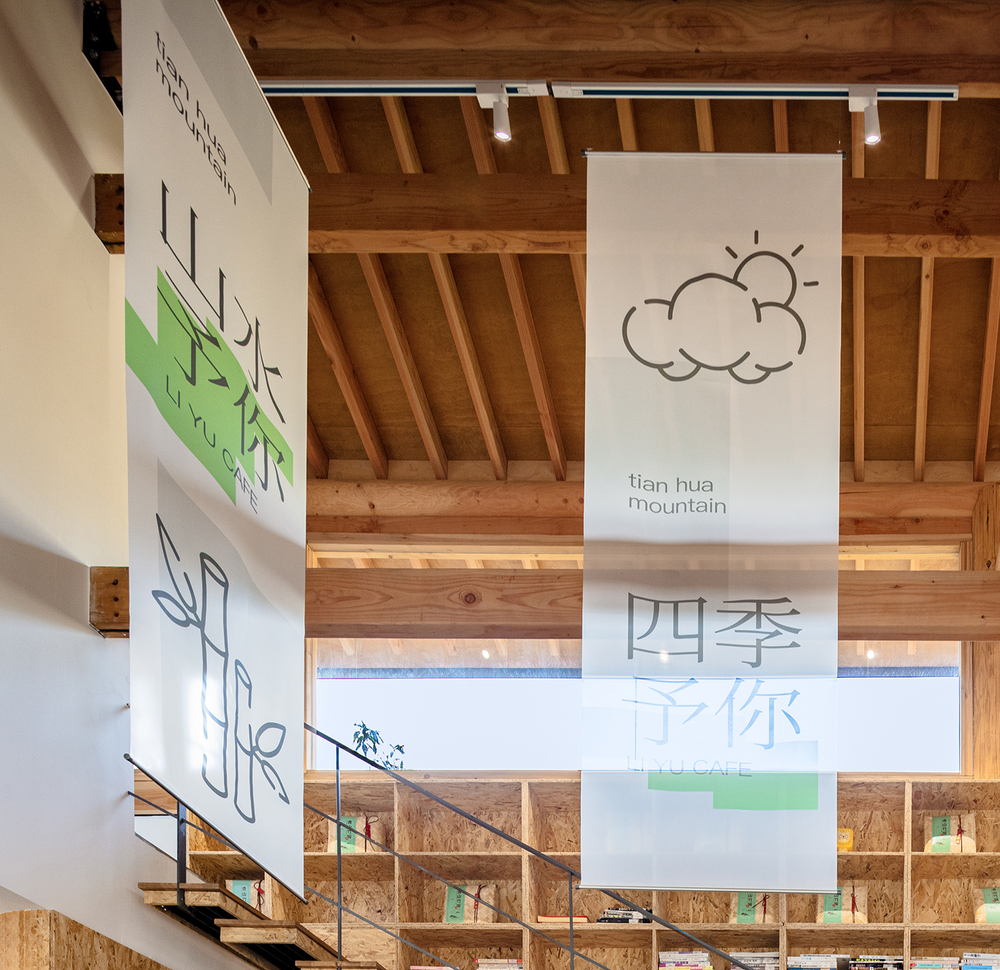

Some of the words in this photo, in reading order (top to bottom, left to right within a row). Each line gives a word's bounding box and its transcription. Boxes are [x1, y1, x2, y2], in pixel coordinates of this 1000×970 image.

[155, 31, 190, 102] tian
[196, 99, 227, 166] hua
[155, 58, 237, 206] mountain
[159, 179, 287, 425] 山水
[156, 269, 286, 503] 予你
[166, 374, 181, 409] LI
[188, 402, 216, 448] YU
[222, 448, 258, 515] CAFE
[628, 473, 669, 493] tian
[676, 477, 714, 493] hua
[628, 496, 727, 514] mountain
[627, 591, 803, 669] 四季
[621, 676, 801, 750] 予你
[653, 759, 684, 775] YU
[692, 759, 752, 778] CAFE
